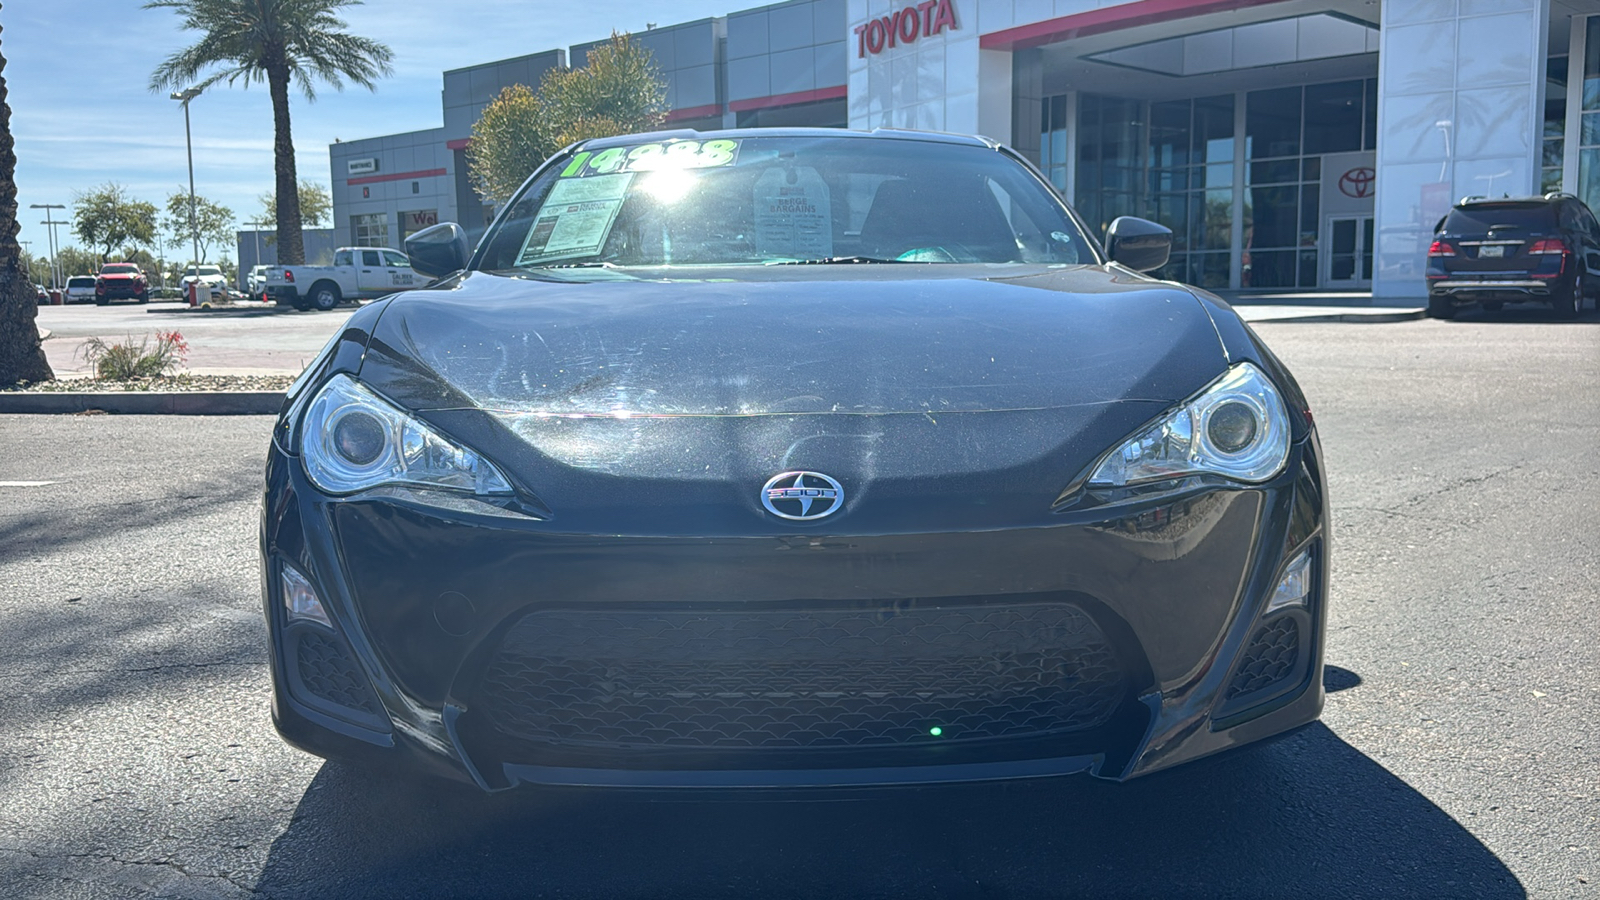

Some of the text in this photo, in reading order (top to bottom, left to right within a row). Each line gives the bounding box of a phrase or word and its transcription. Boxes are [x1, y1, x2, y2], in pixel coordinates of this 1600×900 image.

[854, 0, 958, 59] TOYOTA
[778, 197, 808, 205] BERGE
[770, 205, 816, 213] BARGAINS
[767, 488, 838, 499] SCION
